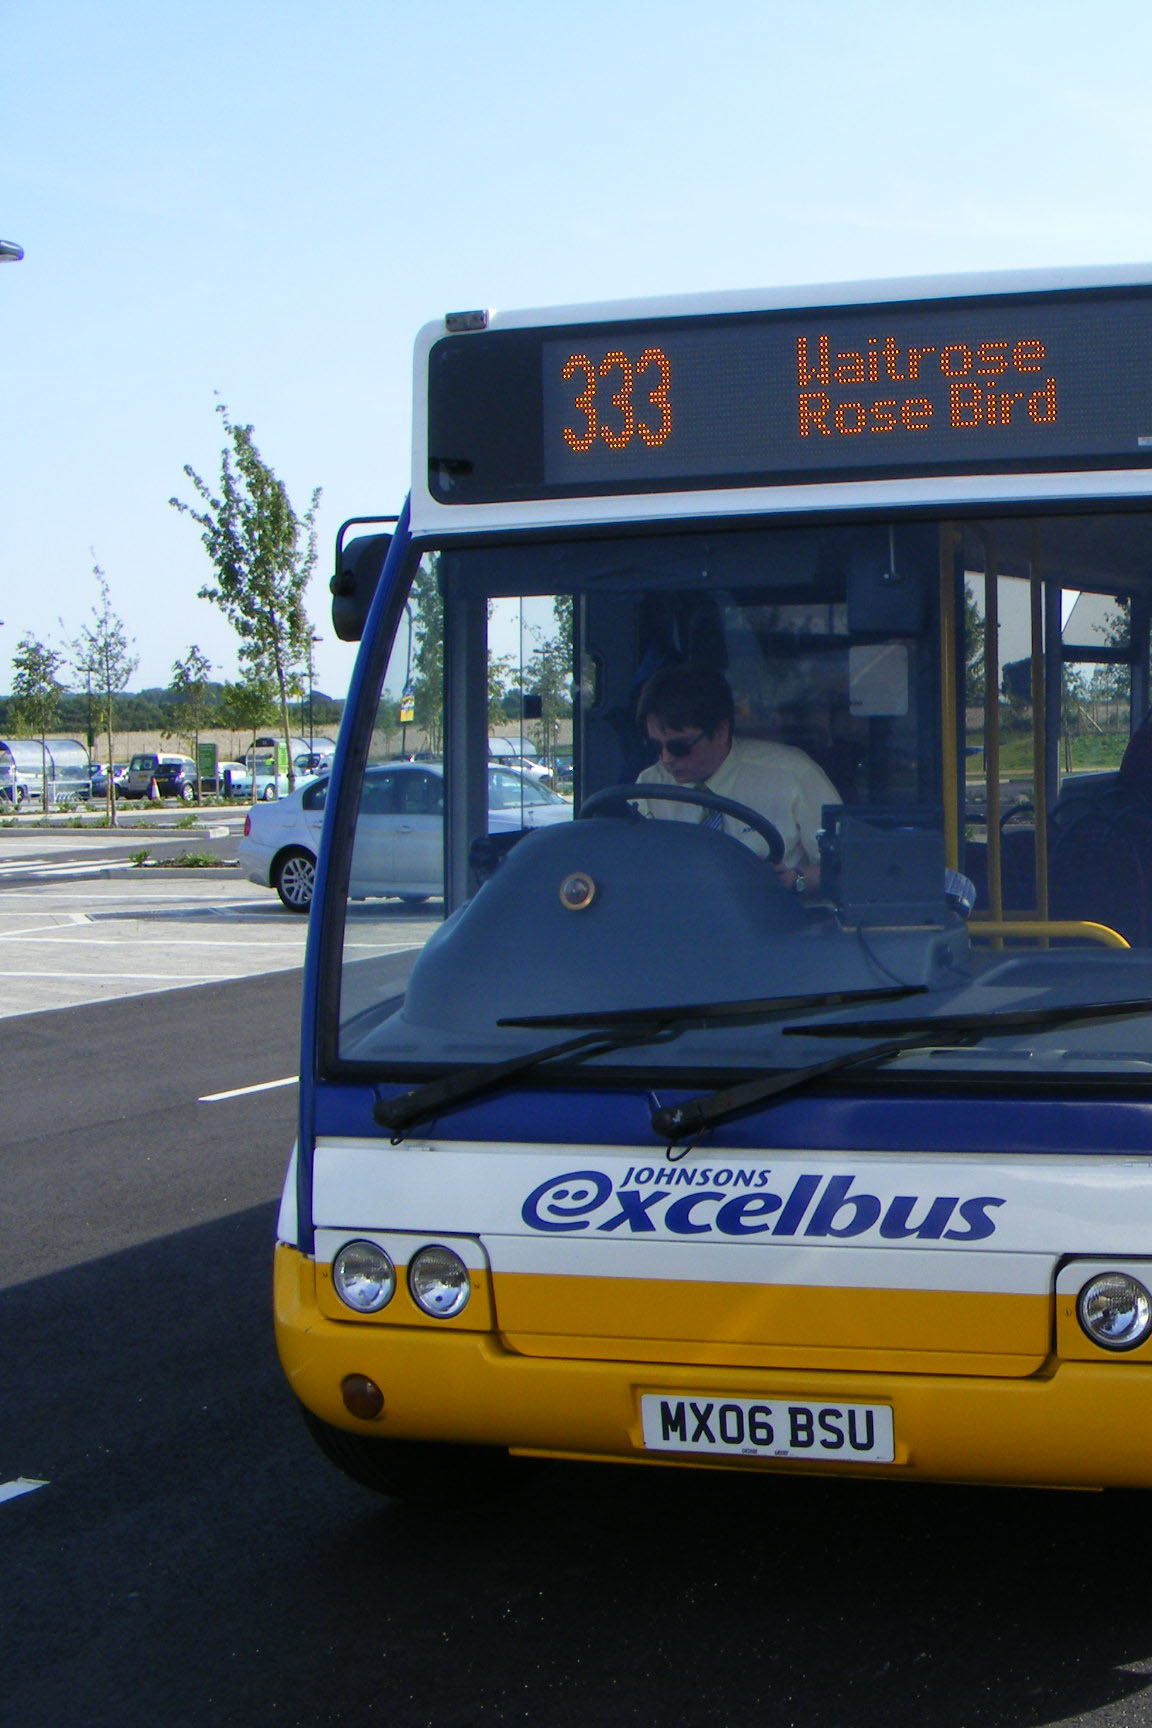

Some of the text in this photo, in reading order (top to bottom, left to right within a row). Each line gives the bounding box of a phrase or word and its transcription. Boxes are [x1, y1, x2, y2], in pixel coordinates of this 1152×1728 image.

[796, 335, 1047, 386] Waitrose
[562, 348, 672, 451] 333
[798, 376, 1058, 437] Rose Bird
[619, 1166, 772, 1189] JOHNSONS
[660, 1400, 876, 1452] MX06 BSU
